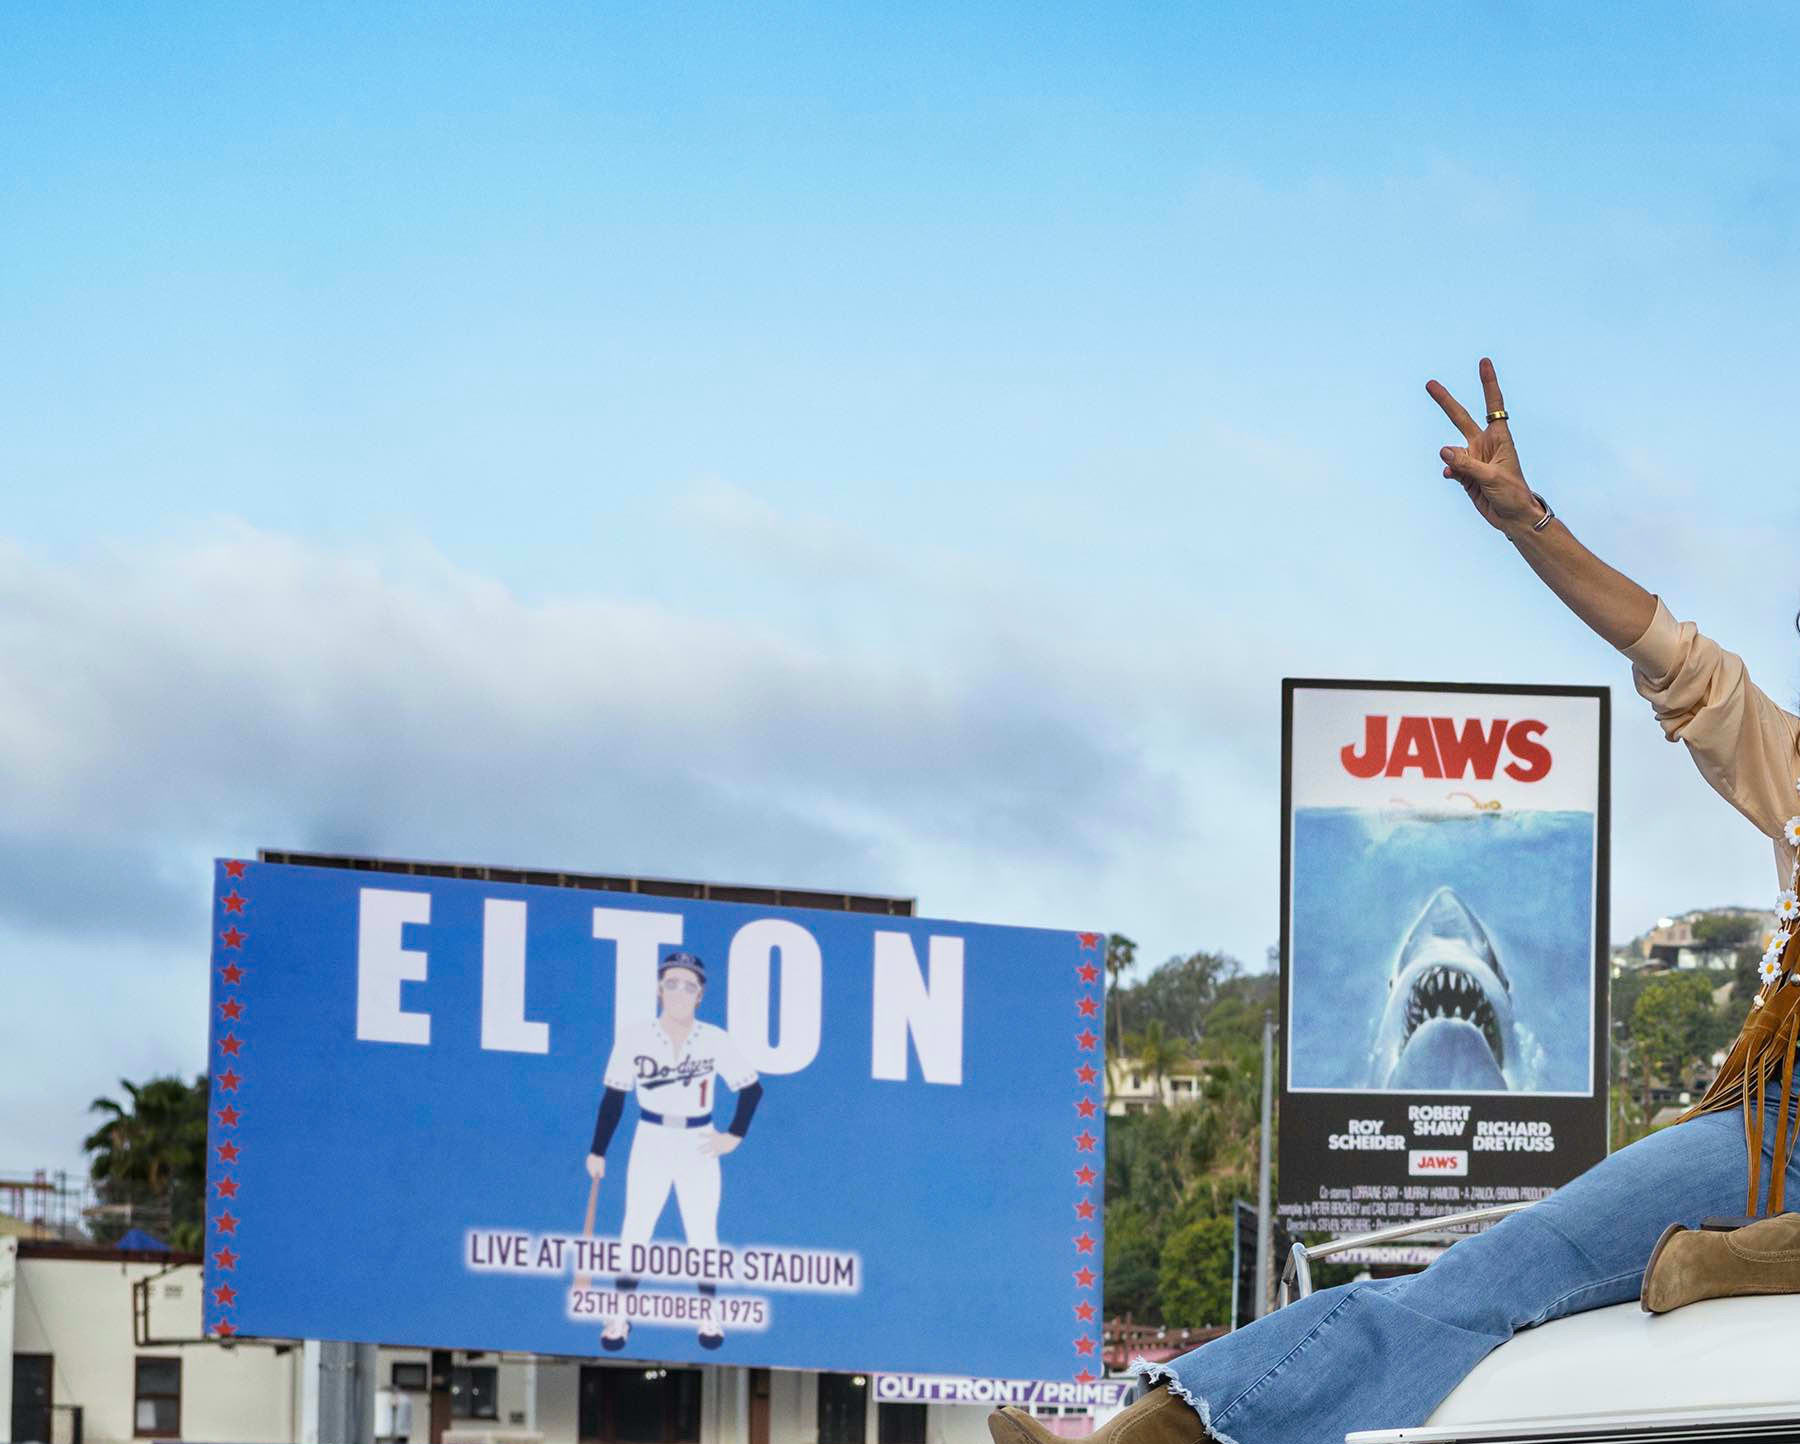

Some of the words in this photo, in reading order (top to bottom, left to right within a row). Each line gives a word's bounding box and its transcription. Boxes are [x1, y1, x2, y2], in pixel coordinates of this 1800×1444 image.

[1341, 715, 1553, 783] JAWS
[356, 887, 965, 1085] ELTON
[698, 1078, 708, 1108] 1
[1408, 1105, 1471, 1121] ROBERT
[1349, 1120, 1384, 1135] ROY
[1413, 1121, 1467, 1136] SHAW
[1477, 1121, 1552, 1137] RICHARD
[1328, 1134, 1406, 1150] SCHEIDER
[1473, 1136, 1555, 1152] DREYFUSS
[1418, 1156, 1458, 1169] JAWS
[472, 1234, 528, 1266] LIVE
[537, 1237, 566, 1269] AT
[575, 1239, 621, 1272] THE
[631, 1244, 734, 1280] DODGER
[743, 1251, 854, 1286] STADIUM
[573, 1291, 619, 1315] 25TH
[626, 1294, 712, 1321] OCTOBER
[719, 1299, 764, 1324] 1975
